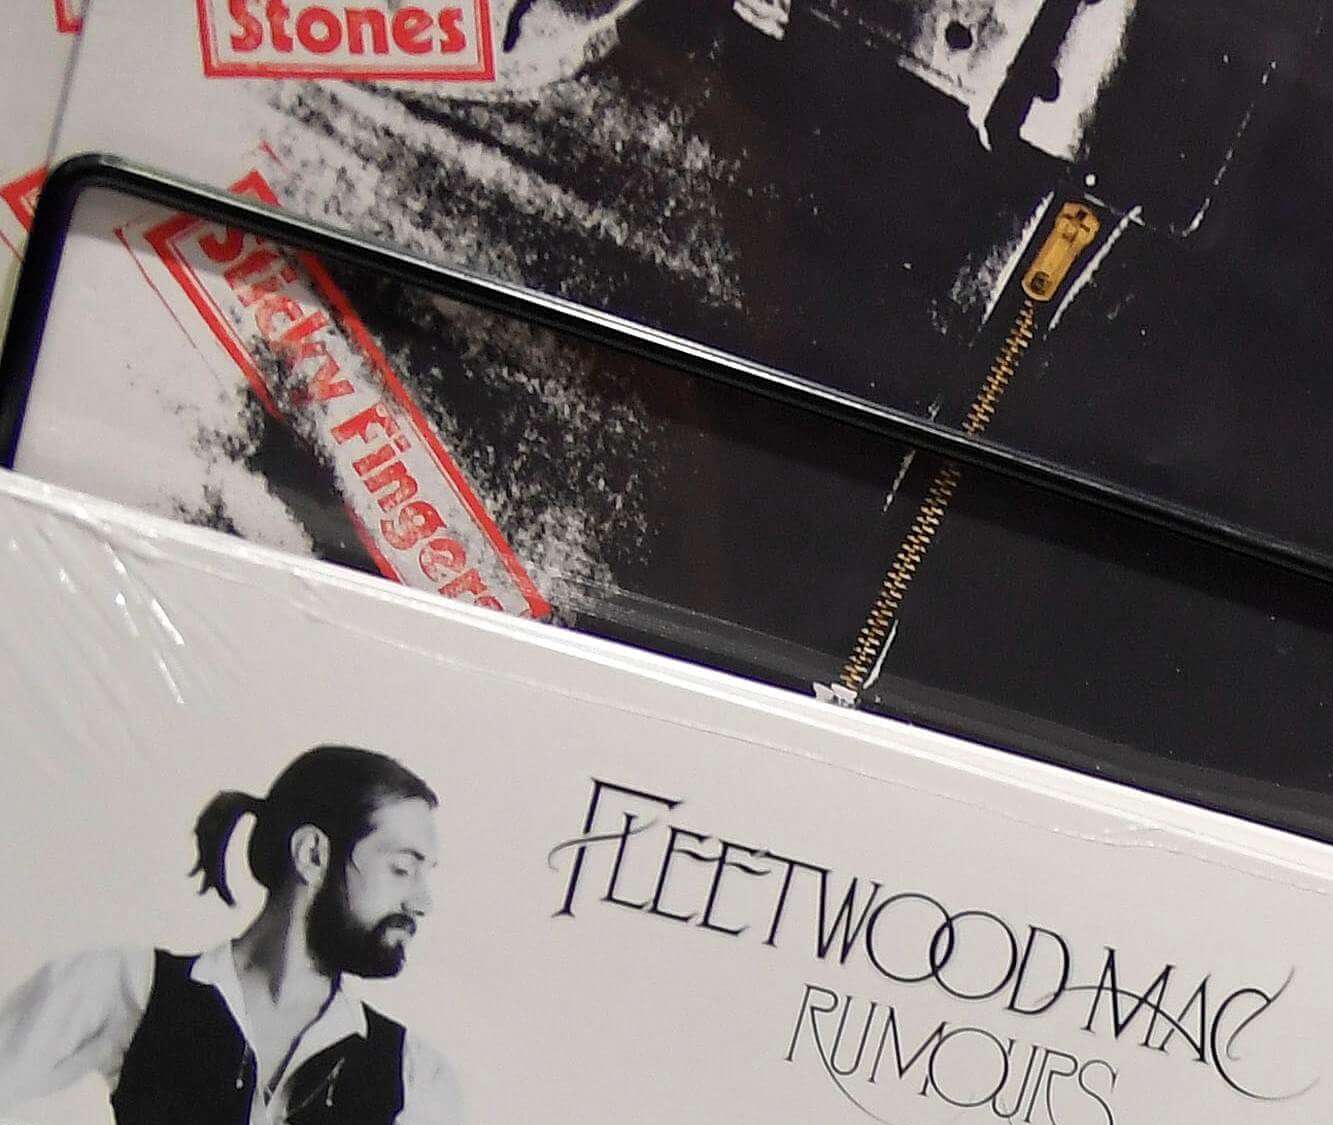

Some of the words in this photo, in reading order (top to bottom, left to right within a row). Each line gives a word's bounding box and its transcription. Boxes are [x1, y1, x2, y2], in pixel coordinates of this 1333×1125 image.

[229, 0, 467, 55] Stones
[548, 778, 1070, 1016] FLEETWOOD
[1065, 945, 1320, 1102] MAC
